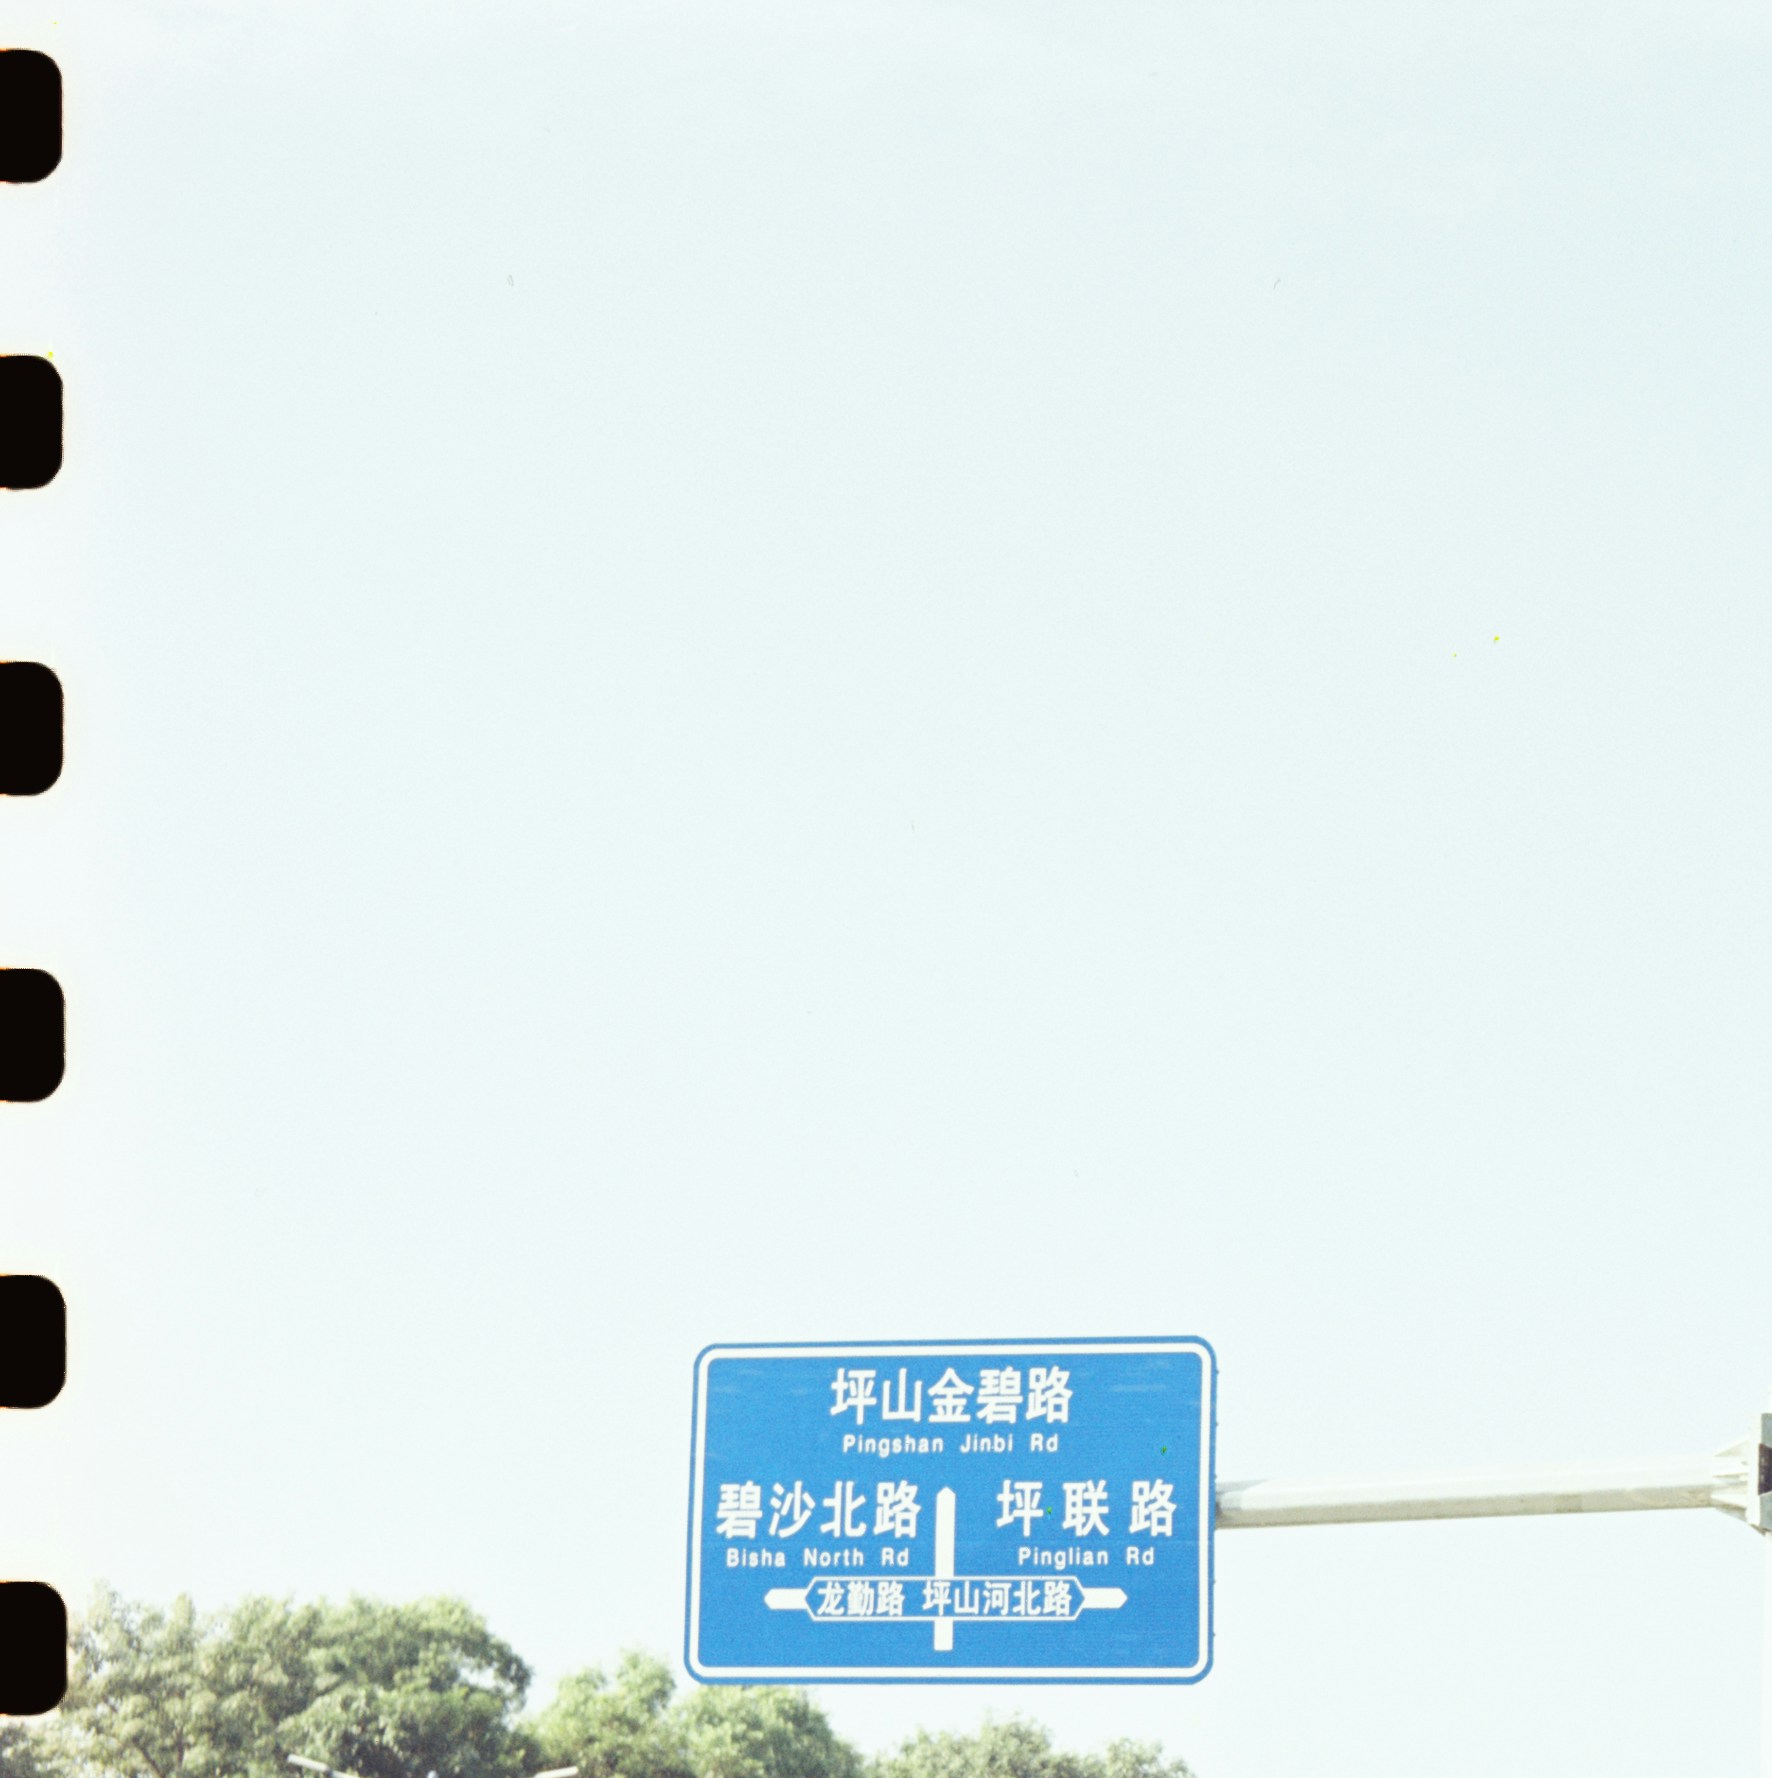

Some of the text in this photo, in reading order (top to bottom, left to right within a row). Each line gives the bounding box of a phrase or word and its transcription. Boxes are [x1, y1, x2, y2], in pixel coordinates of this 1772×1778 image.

[829, 1366, 1074, 1425] 坪山金碧路
[842, 1432, 1059, 1458] Pingshan Jinbi Rd
[715, 1480, 922, 1540] 碧沙北路
[996, 1478, 1177, 1537] 坪联路
[726, 1547, 909, 1567] Bisha North Rd
[1018, 1546, 1155, 1570] Pinglian Rd
[816, 1579, 1073, 1617] 龙勤路 坪山河北路
